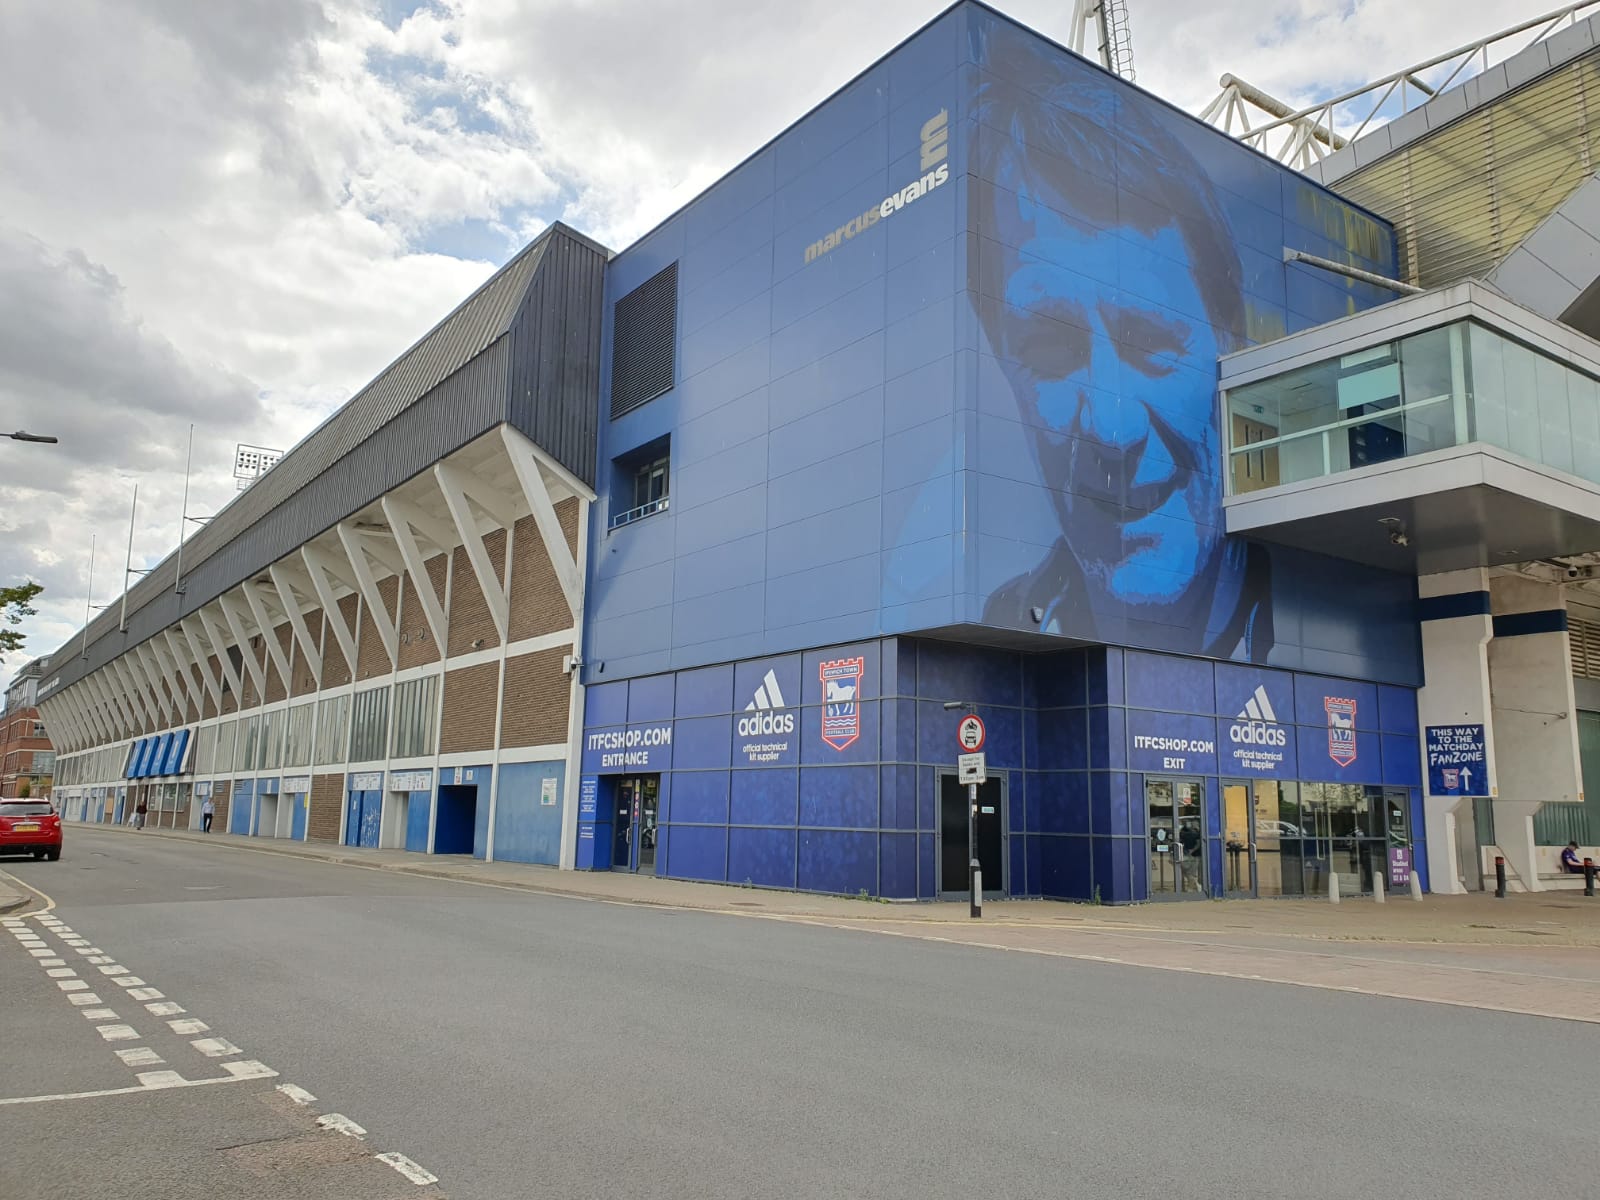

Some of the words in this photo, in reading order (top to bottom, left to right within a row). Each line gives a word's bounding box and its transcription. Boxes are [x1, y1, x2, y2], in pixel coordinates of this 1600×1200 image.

[738, 710, 794, 737] adidas
[1230, 720, 1286, 746] adidas
[1431, 728, 1453, 737] THIS
[1455, 727, 1479, 736] WAY
[588, 727, 672, 751] ITFCSHOP.COM
[1134, 735, 1214, 753] ITFCSHOP.COM
[1438, 736, 1451, 744] TO
[1453, 735, 1473, 743] THE
[742, 744, 761, 753] official
[761, 741, 788, 752] technical
[1429, 743, 1484, 752] MATCHDAY
[602, 751, 649, 767] ENTRANCE
[749, 752, 757, 761] kit
[757, 751, 780, 763] supplier
[1233, 749, 1255, 760] official
[1255, 751, 1283, 761] technical
[1163, 757, 1186, 769] EXIT
[1242, 758, 1251, 768] kit
[1251, 760, 1276, 771] supplier
